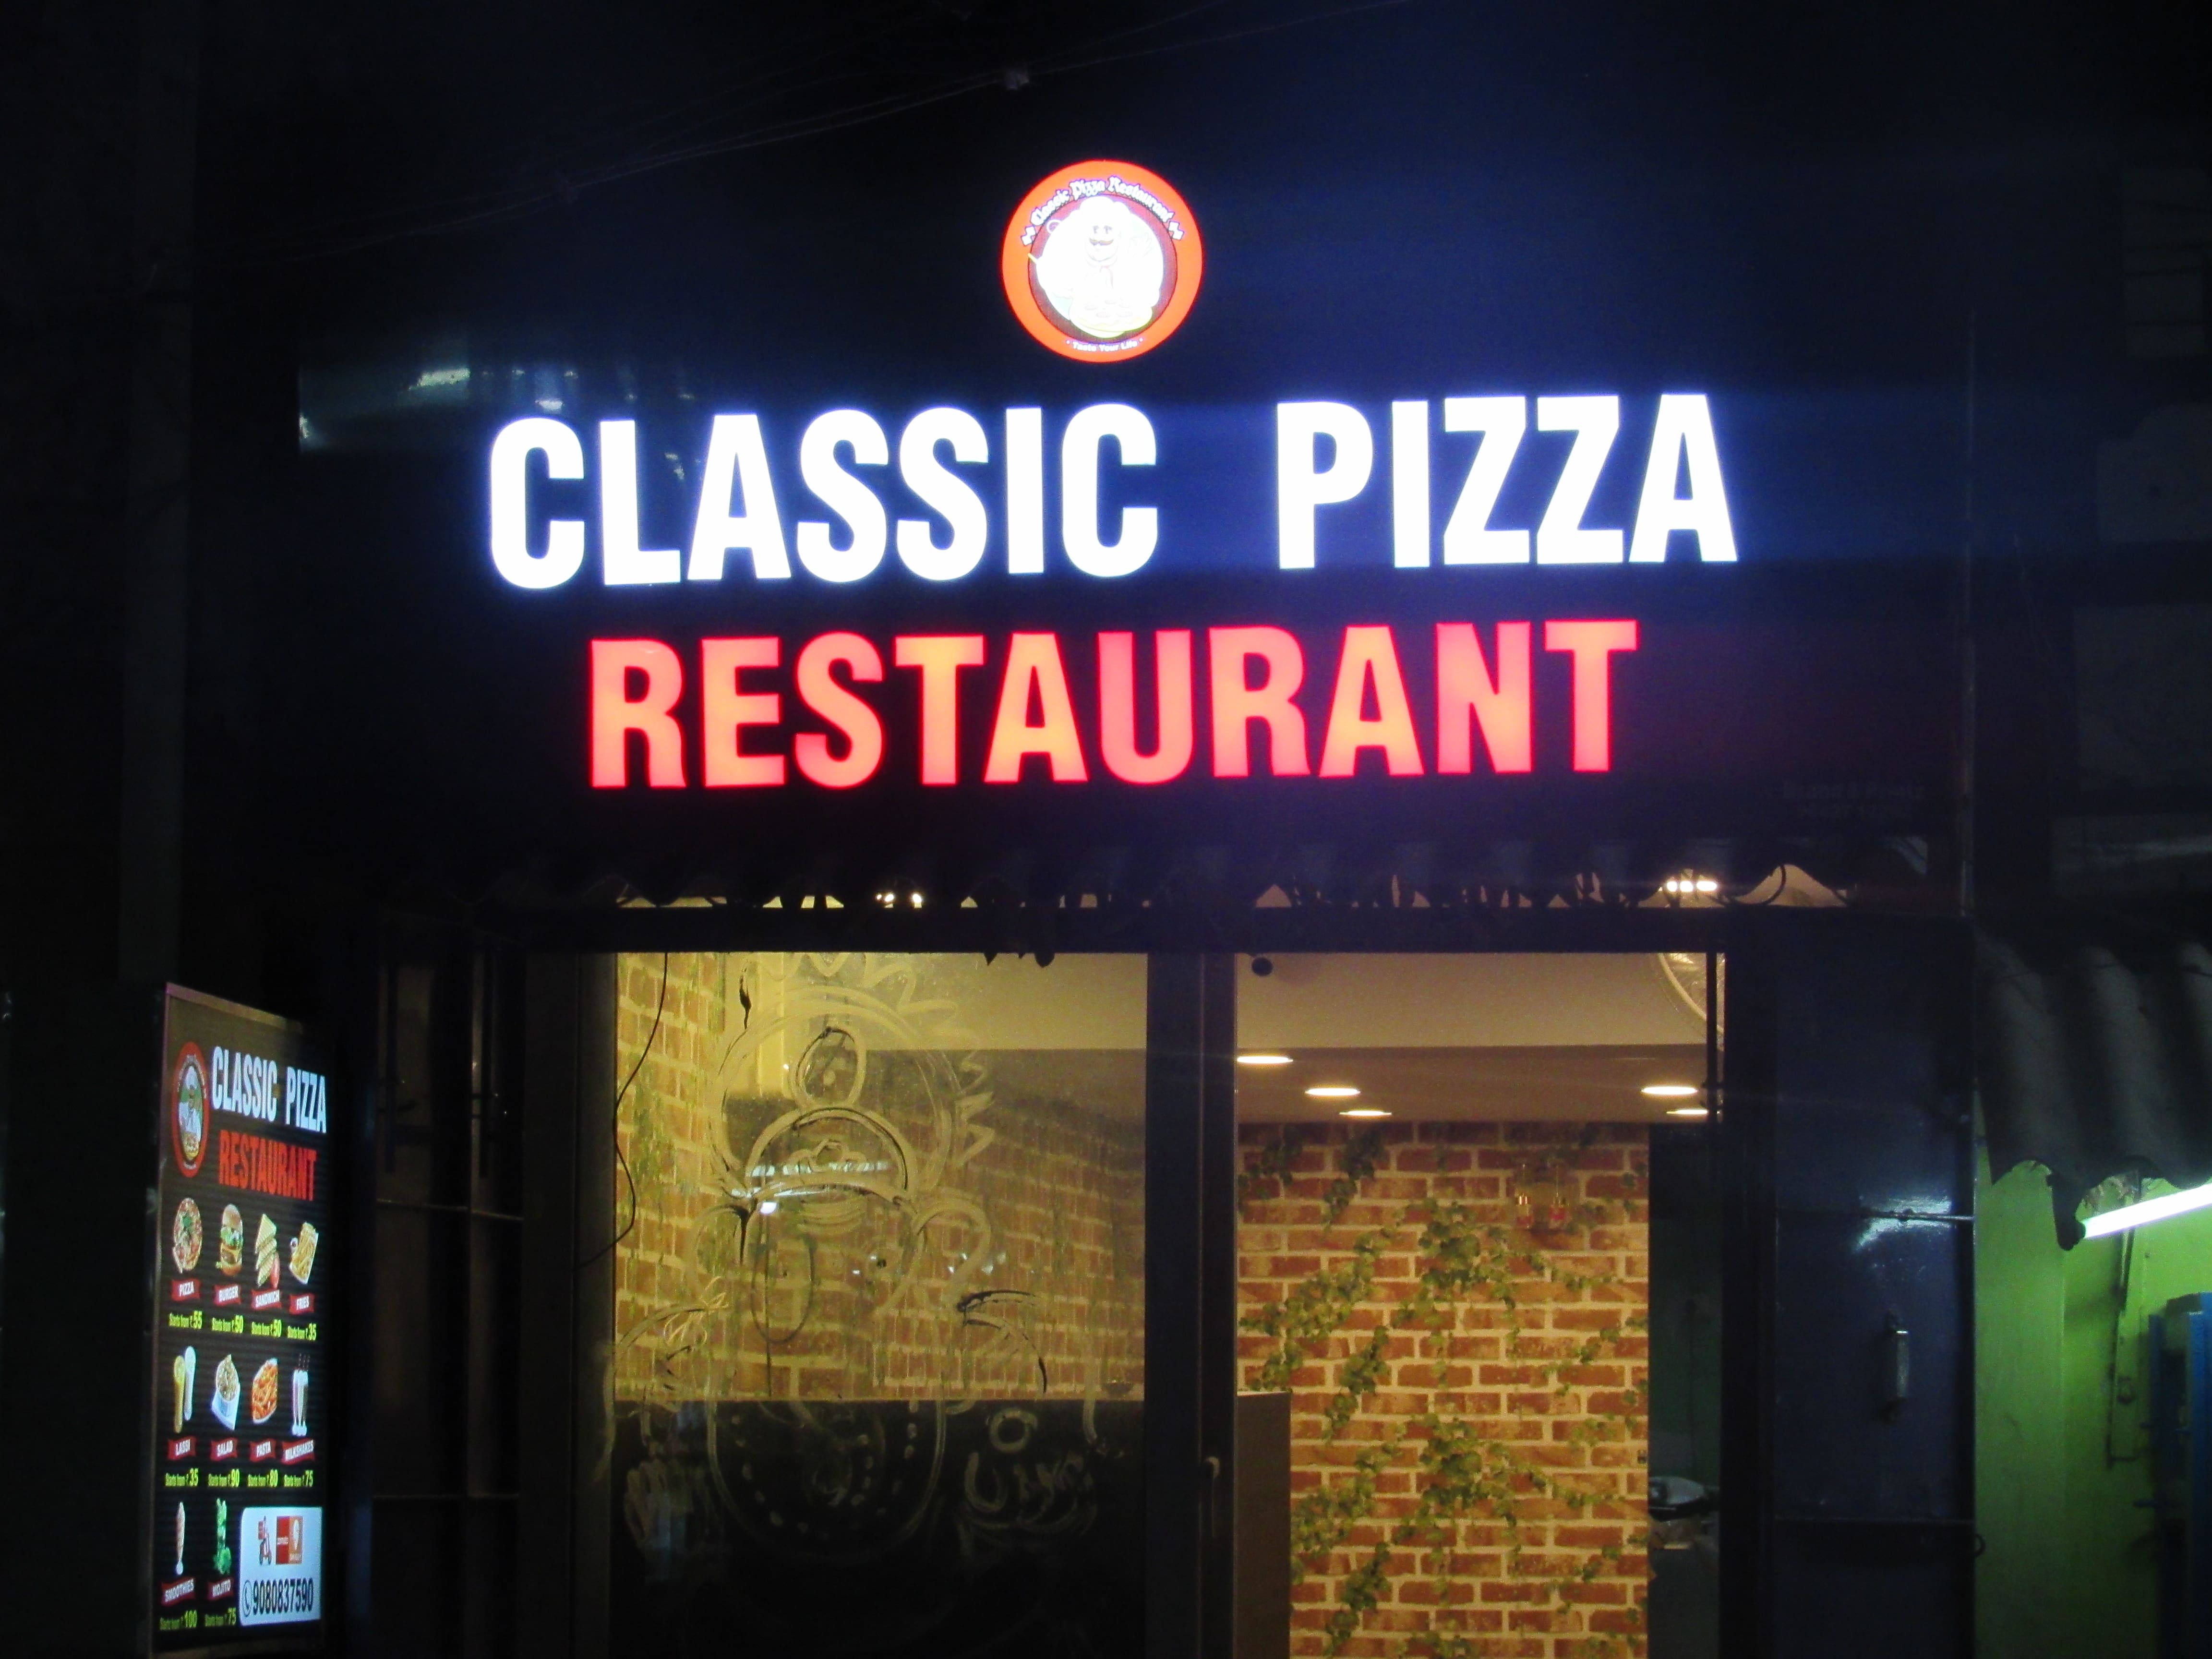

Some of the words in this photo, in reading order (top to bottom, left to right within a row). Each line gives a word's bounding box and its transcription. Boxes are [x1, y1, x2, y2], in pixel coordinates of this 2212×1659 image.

[1069, 179, 1106, 200] Pizza
[490, 402, 1158, 589] CLASSIC
[1277, 393, 1738, 570] PIZZA
[589, 620, 1638, 789] RESTAURANT
[211, 1046, 278, 1122] CLASSIC
[286, 1066, 327, 1133] PIZZA
[219, 1130, 317, 1201] RESTAURANT
[179, 1281, 194, 1297] PIZZA
[257, 1441, 271, 1457] PASTA
[253, 1578, 314, 1615] 9080837590
